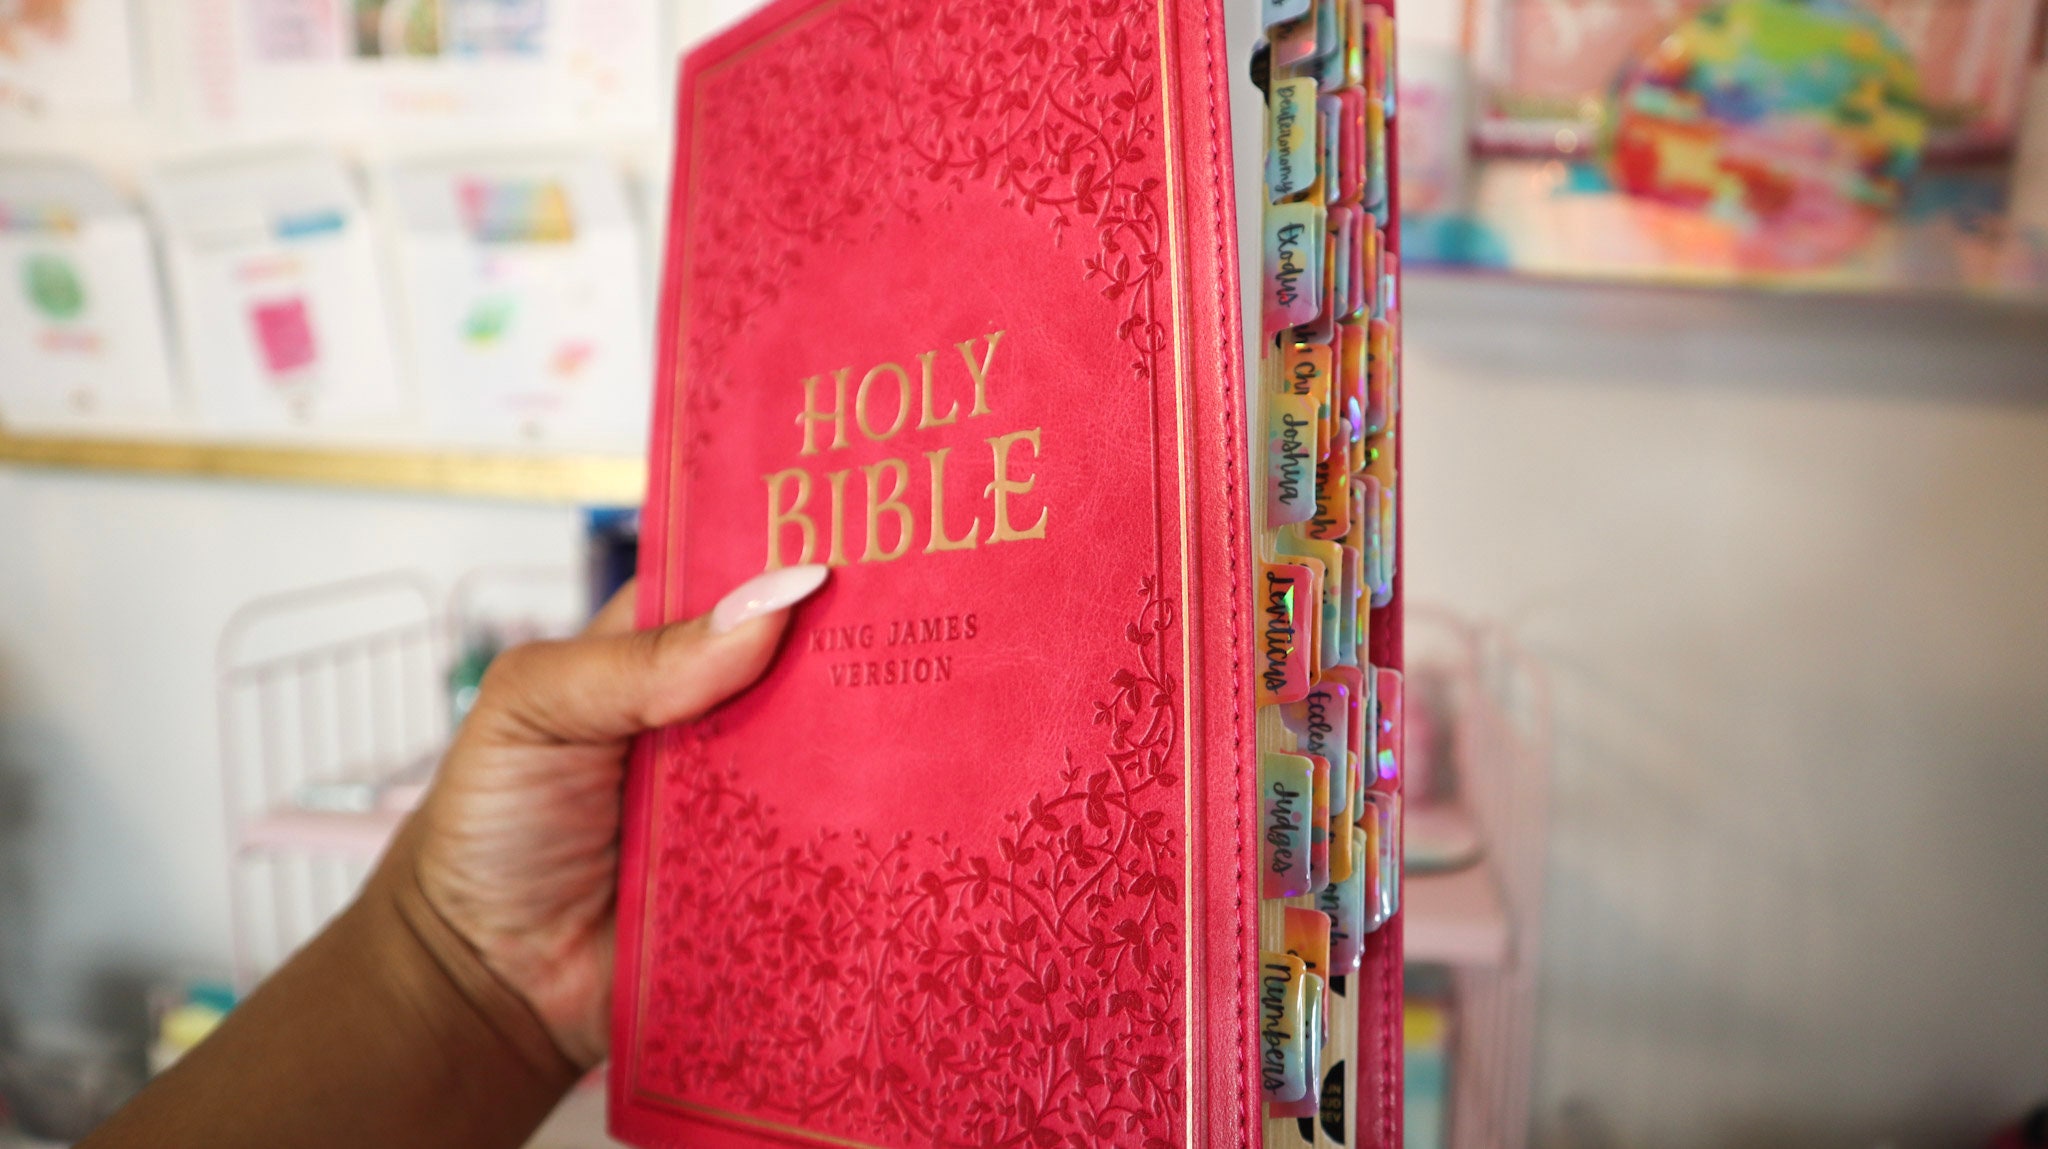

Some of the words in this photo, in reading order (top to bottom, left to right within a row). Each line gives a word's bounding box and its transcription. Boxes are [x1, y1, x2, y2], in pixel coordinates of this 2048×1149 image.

[1274, 85, 1297, 194] Deuteronomy
[1274, 223, 1305, 308] Exodus
[796, 330, 1005, 457] HOLY
[763, 427, 1048, 571] BIBLE
[1279, 413, 1309, 506] Joshua
[809, 625, 874, 653] KING
[887, 614, 978, 646] JAMES
[830, 656, 952, 688] VERSION
[1262, 571, 1296, 695] Leviticus
[1267, 782, 1299, 877] Judges
[1261, 963, 1293, 1096] Numbers
